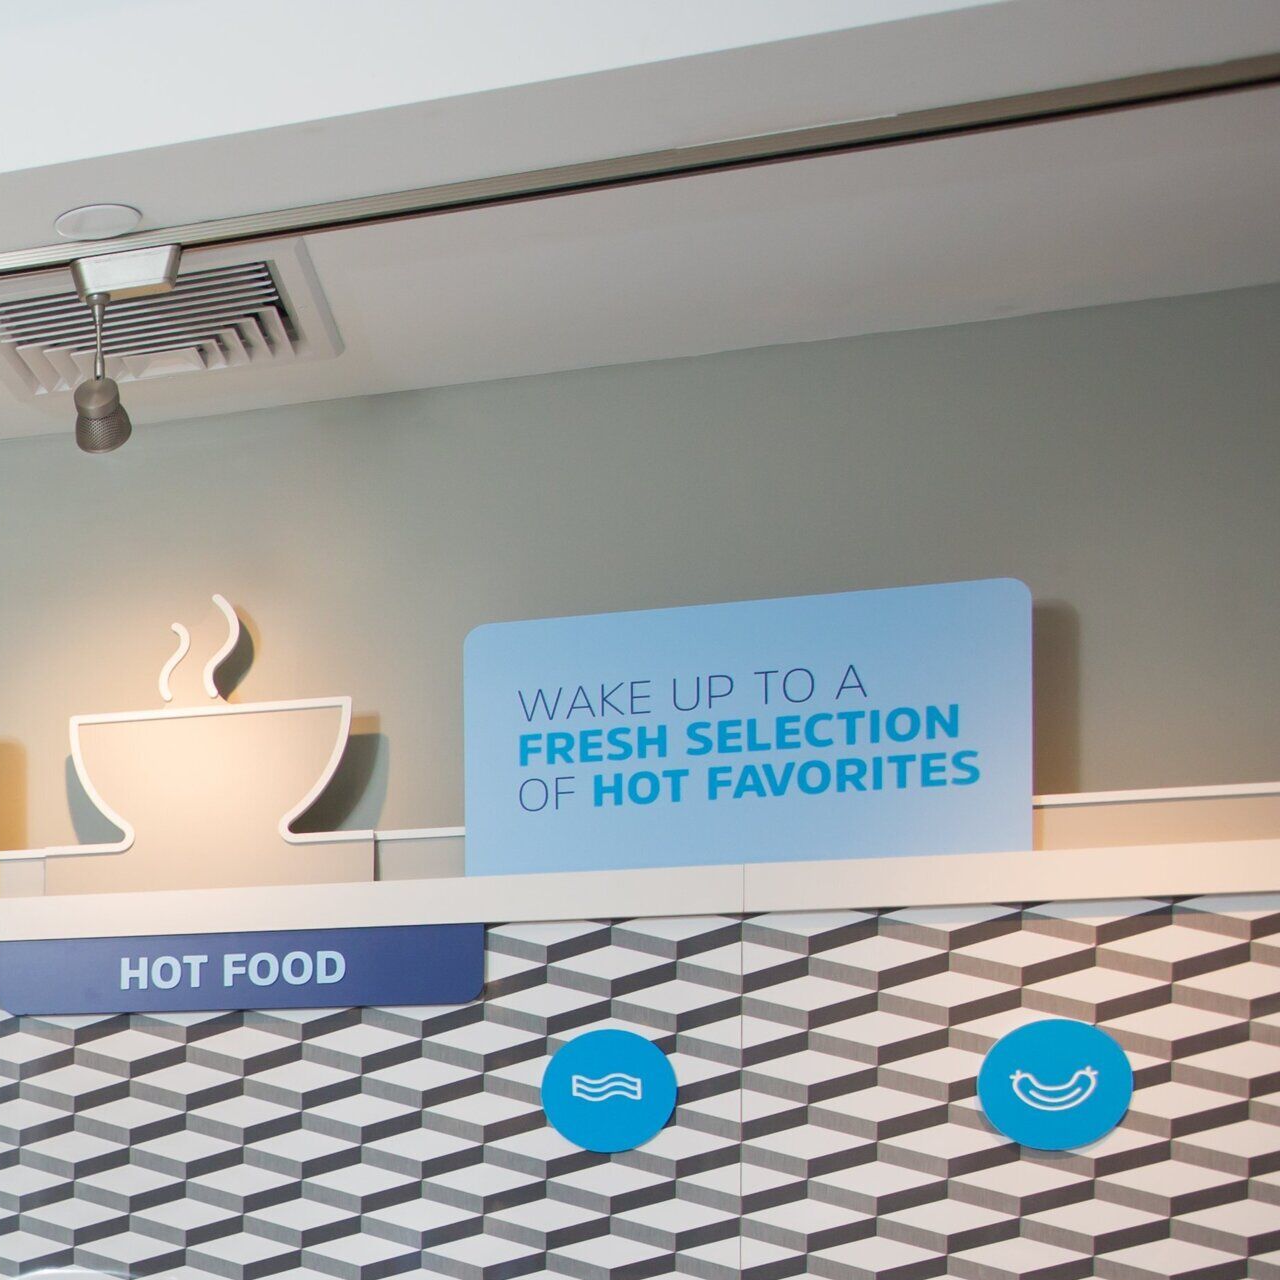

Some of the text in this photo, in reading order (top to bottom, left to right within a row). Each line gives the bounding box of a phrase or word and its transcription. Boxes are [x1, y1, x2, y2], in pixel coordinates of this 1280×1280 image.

[517, 664, 868, 723] WAKE UP TO A
[518, 703, 960, 767] FRESH SELECTION
[518, 749, 981, 812] OF HOT FAVORITES
[120, 950, 347, 990] HOT FOOD
